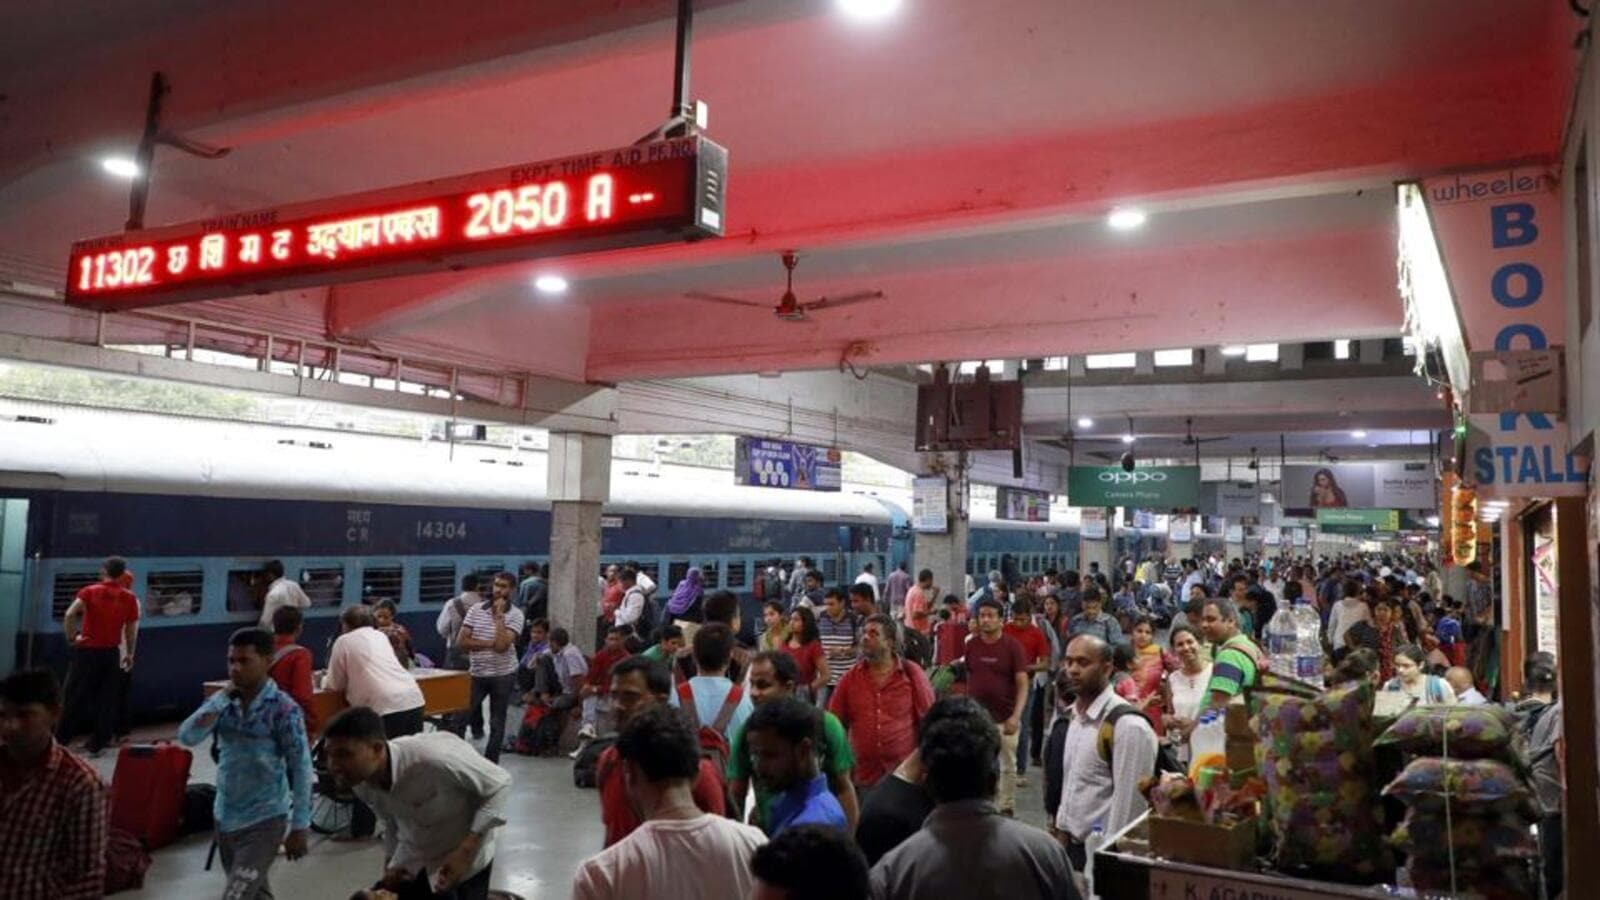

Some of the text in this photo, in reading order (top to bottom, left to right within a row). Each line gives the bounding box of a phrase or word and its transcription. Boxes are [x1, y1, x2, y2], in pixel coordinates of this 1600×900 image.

[561, 153, 602, 176] TIME
[612, 148, 641, 166] A/D
[79, 246, 156, 290] 11302
[239, 234, 261, 263] म
[464, 181, 568, 238] 2050
[587, 173, 614, 221] A
[1474, 445, 1587, 485] STALL
[416, 520, 467, 540] 14304
